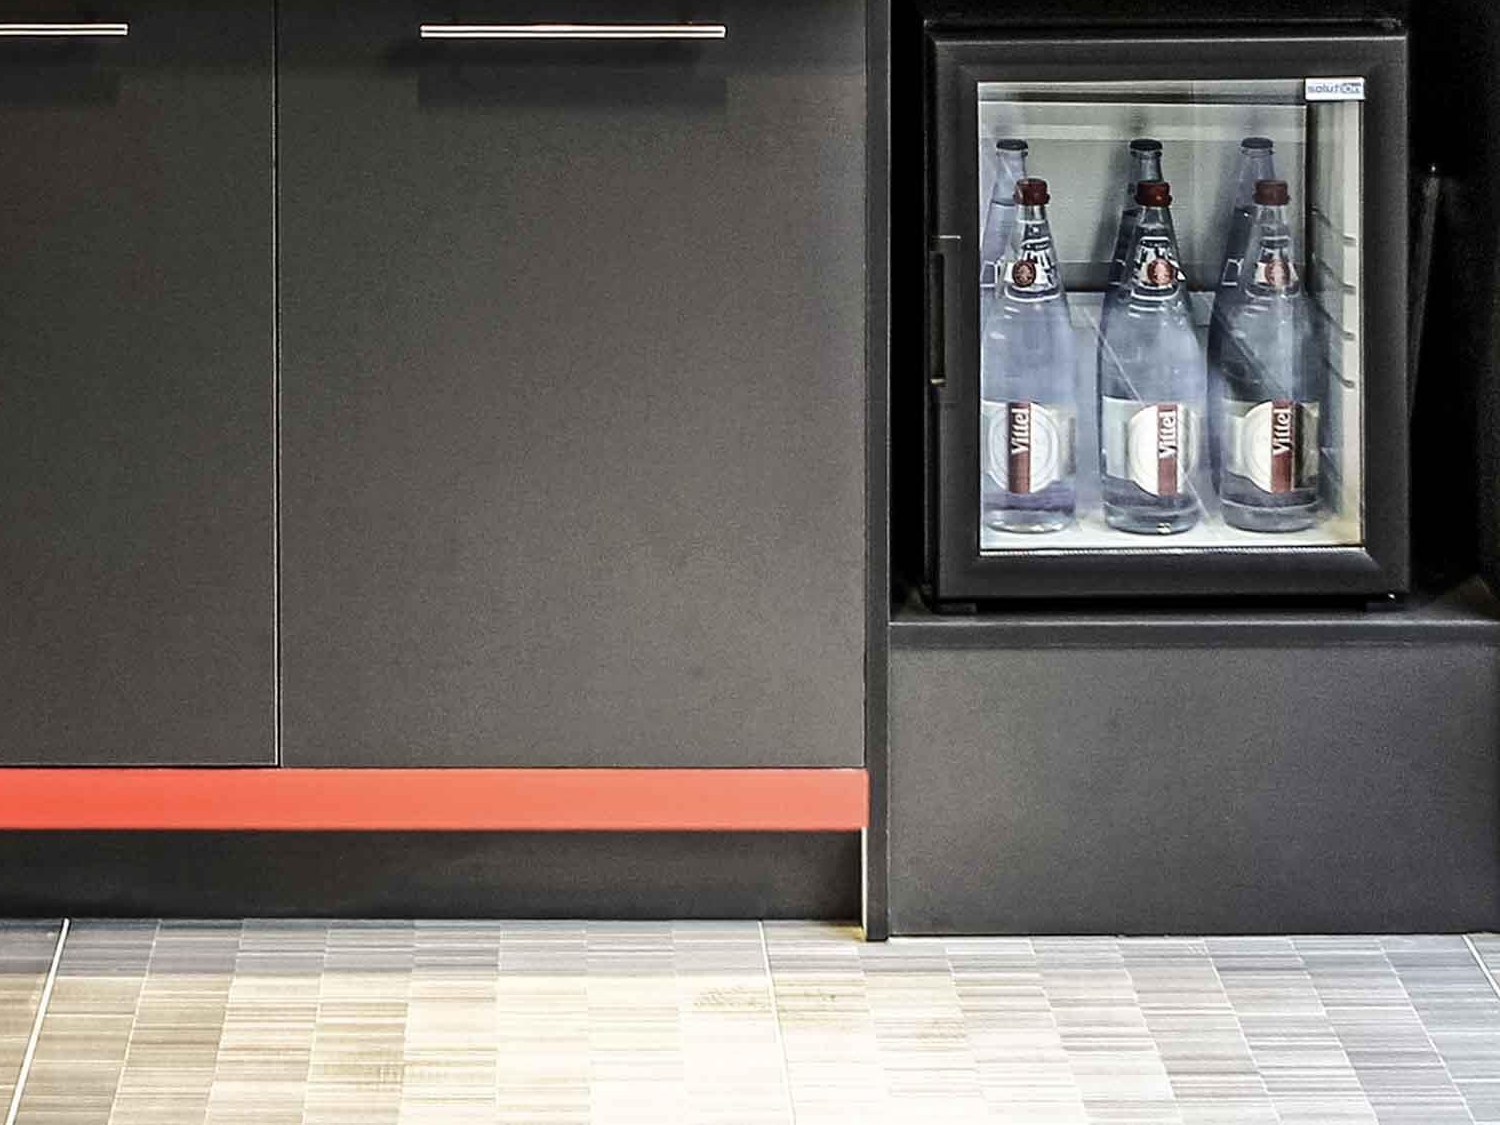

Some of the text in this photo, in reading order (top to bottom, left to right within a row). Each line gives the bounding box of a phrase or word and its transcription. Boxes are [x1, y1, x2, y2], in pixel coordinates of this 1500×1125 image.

[1011, 408, 1029, 455] Vittel
[1159, 411, 1177, 459] Vittel
[1272, 408, 1291, 456] Vittel
